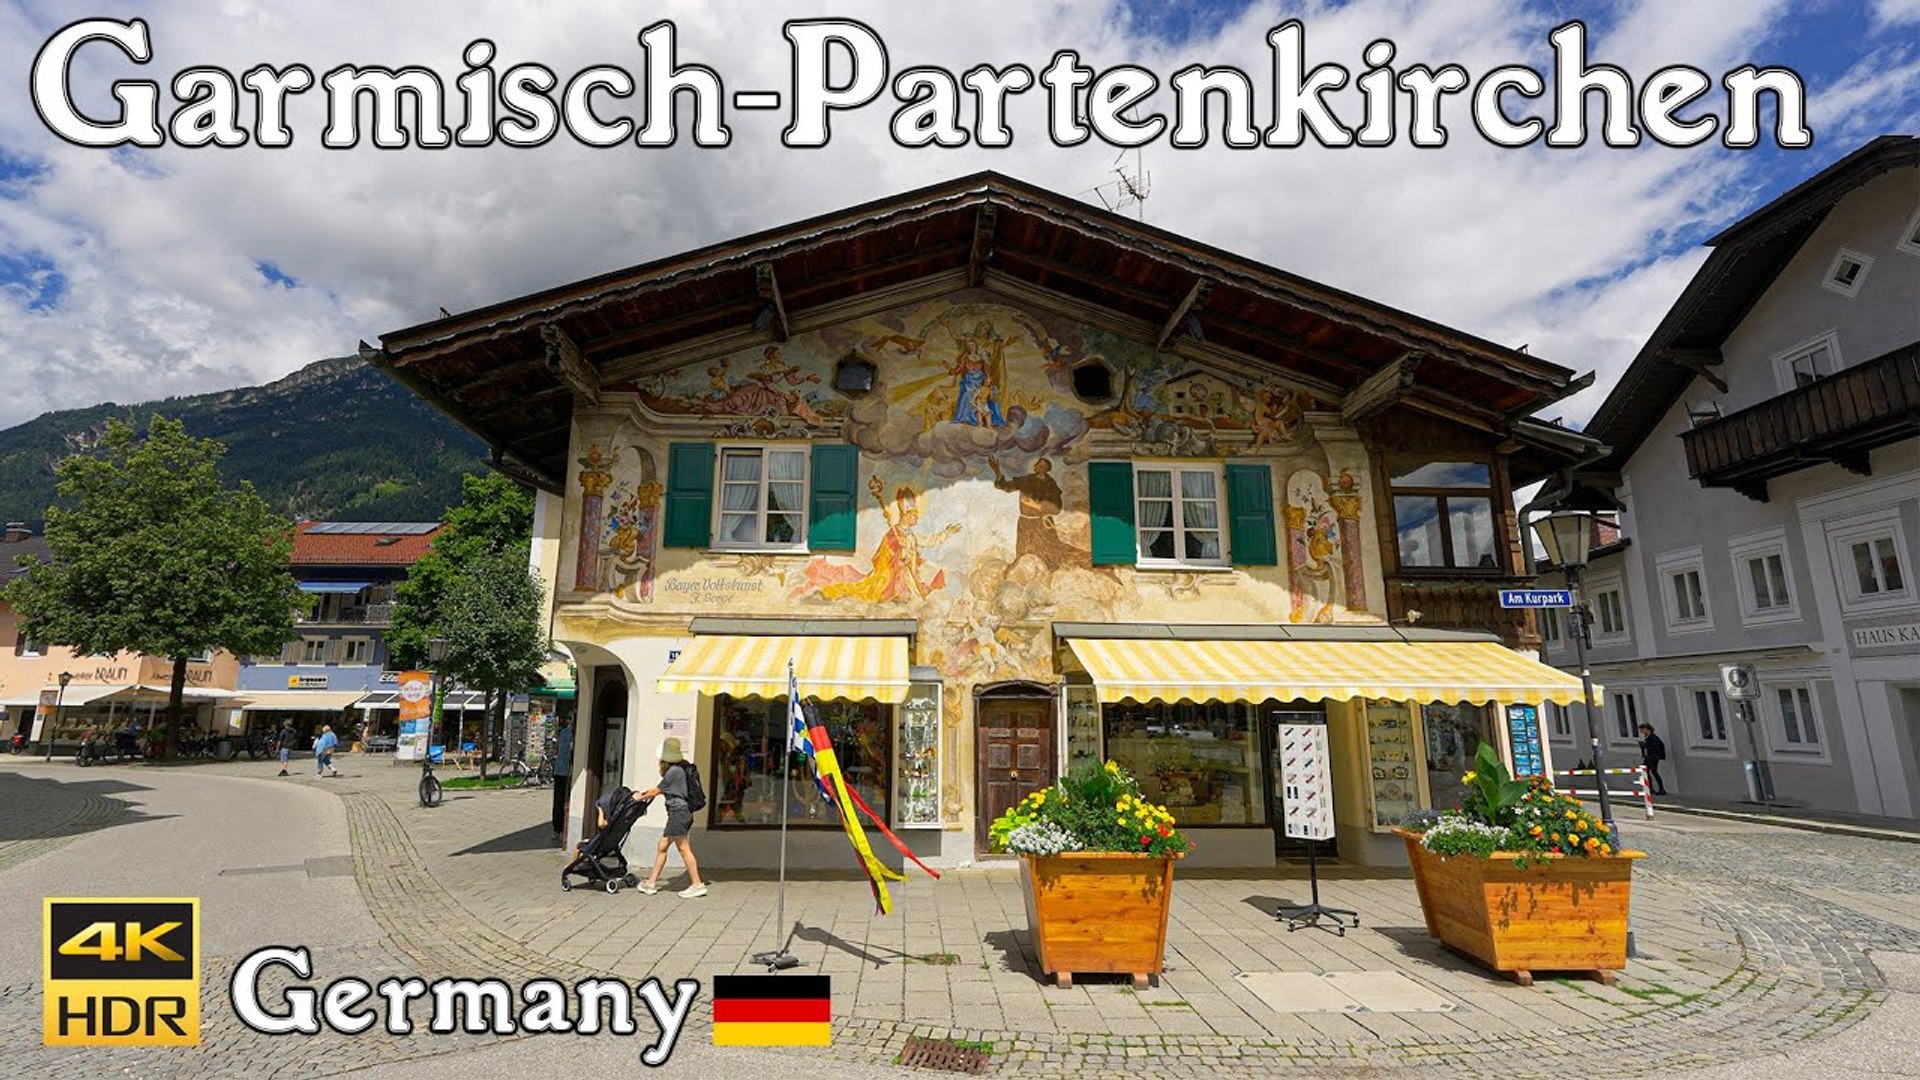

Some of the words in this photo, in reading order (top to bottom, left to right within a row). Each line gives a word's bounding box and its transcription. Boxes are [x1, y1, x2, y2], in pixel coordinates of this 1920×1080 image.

[1508, 592, 1524, 604] Am
[1525, 592, 1565, 607] Kurpark
[1855, 629, 1896, 645] HAUS
